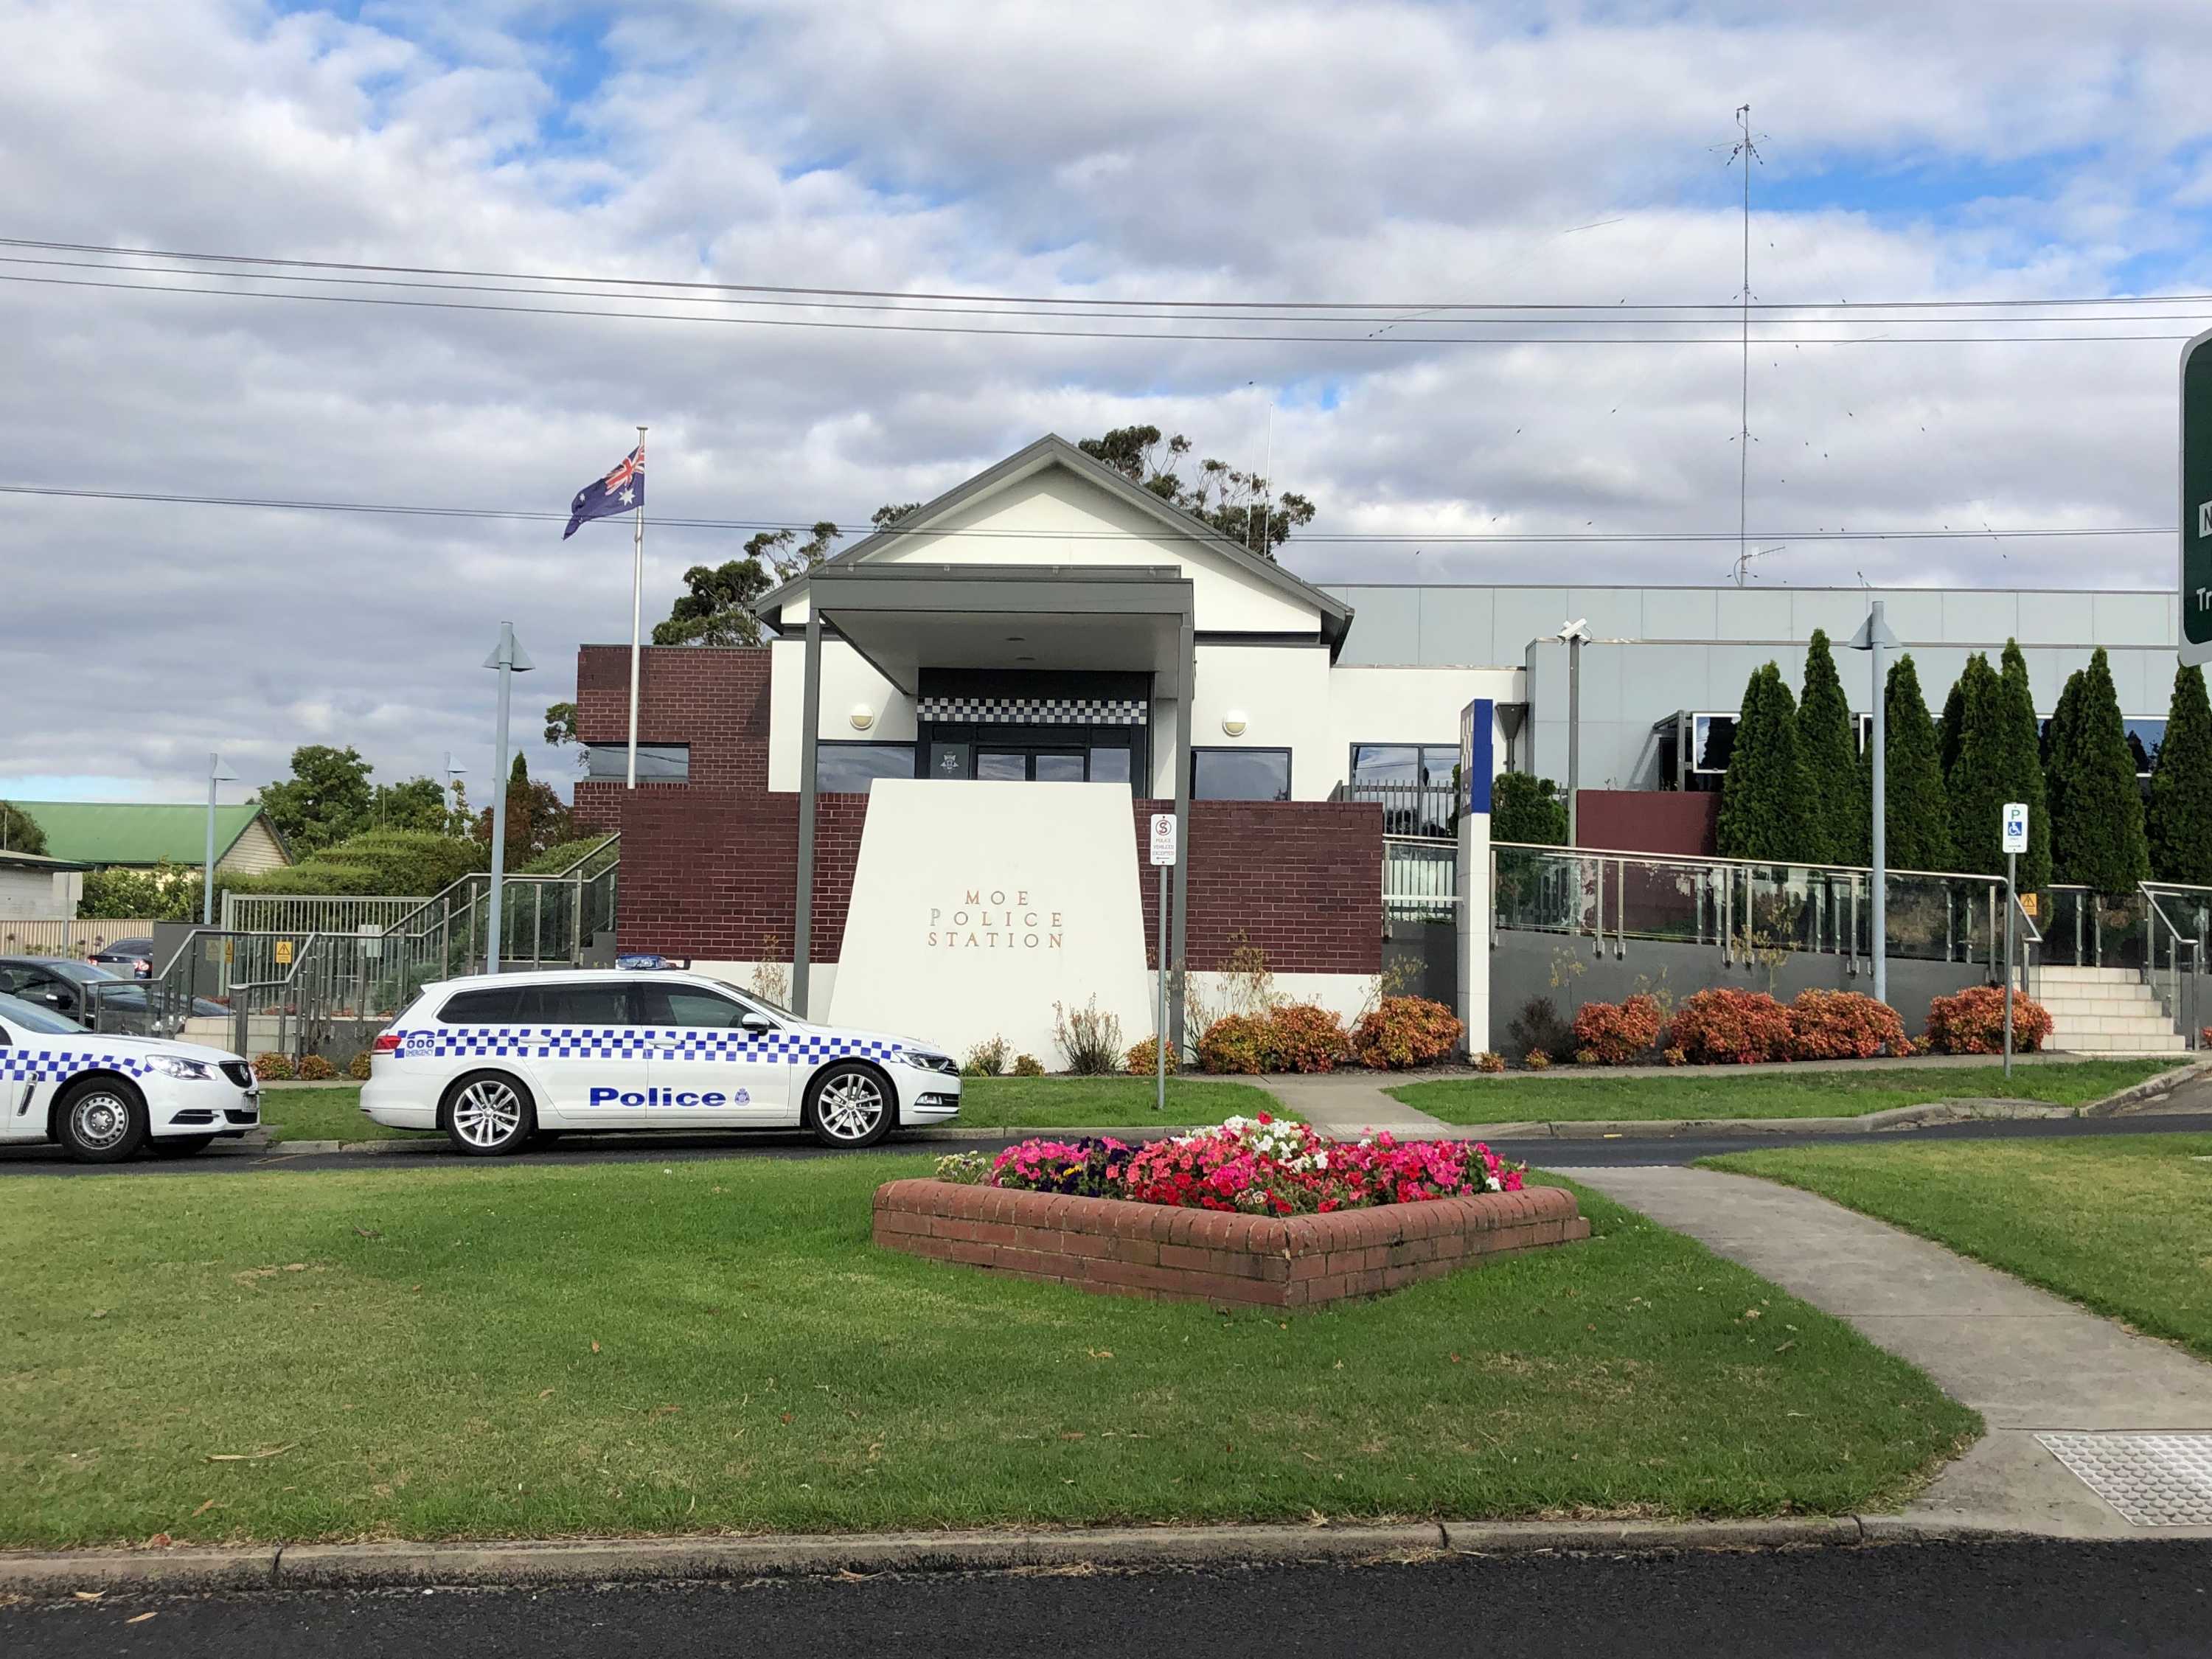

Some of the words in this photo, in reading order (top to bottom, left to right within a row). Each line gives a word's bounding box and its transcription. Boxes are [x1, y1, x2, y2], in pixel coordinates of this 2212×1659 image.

[2205, 506, 2212, 531] N
[2197, 587, 2212, 611] Tr
[2011, 809, 2020, 819] P
[965, 890, 1029, 905] MOE
[930, 908, 1062, 927] POLICE
[928, 932, 1063, 948] STATION
[406, 1040, 435, 1049] 000
[590, 1088, 727, 1107] Police
